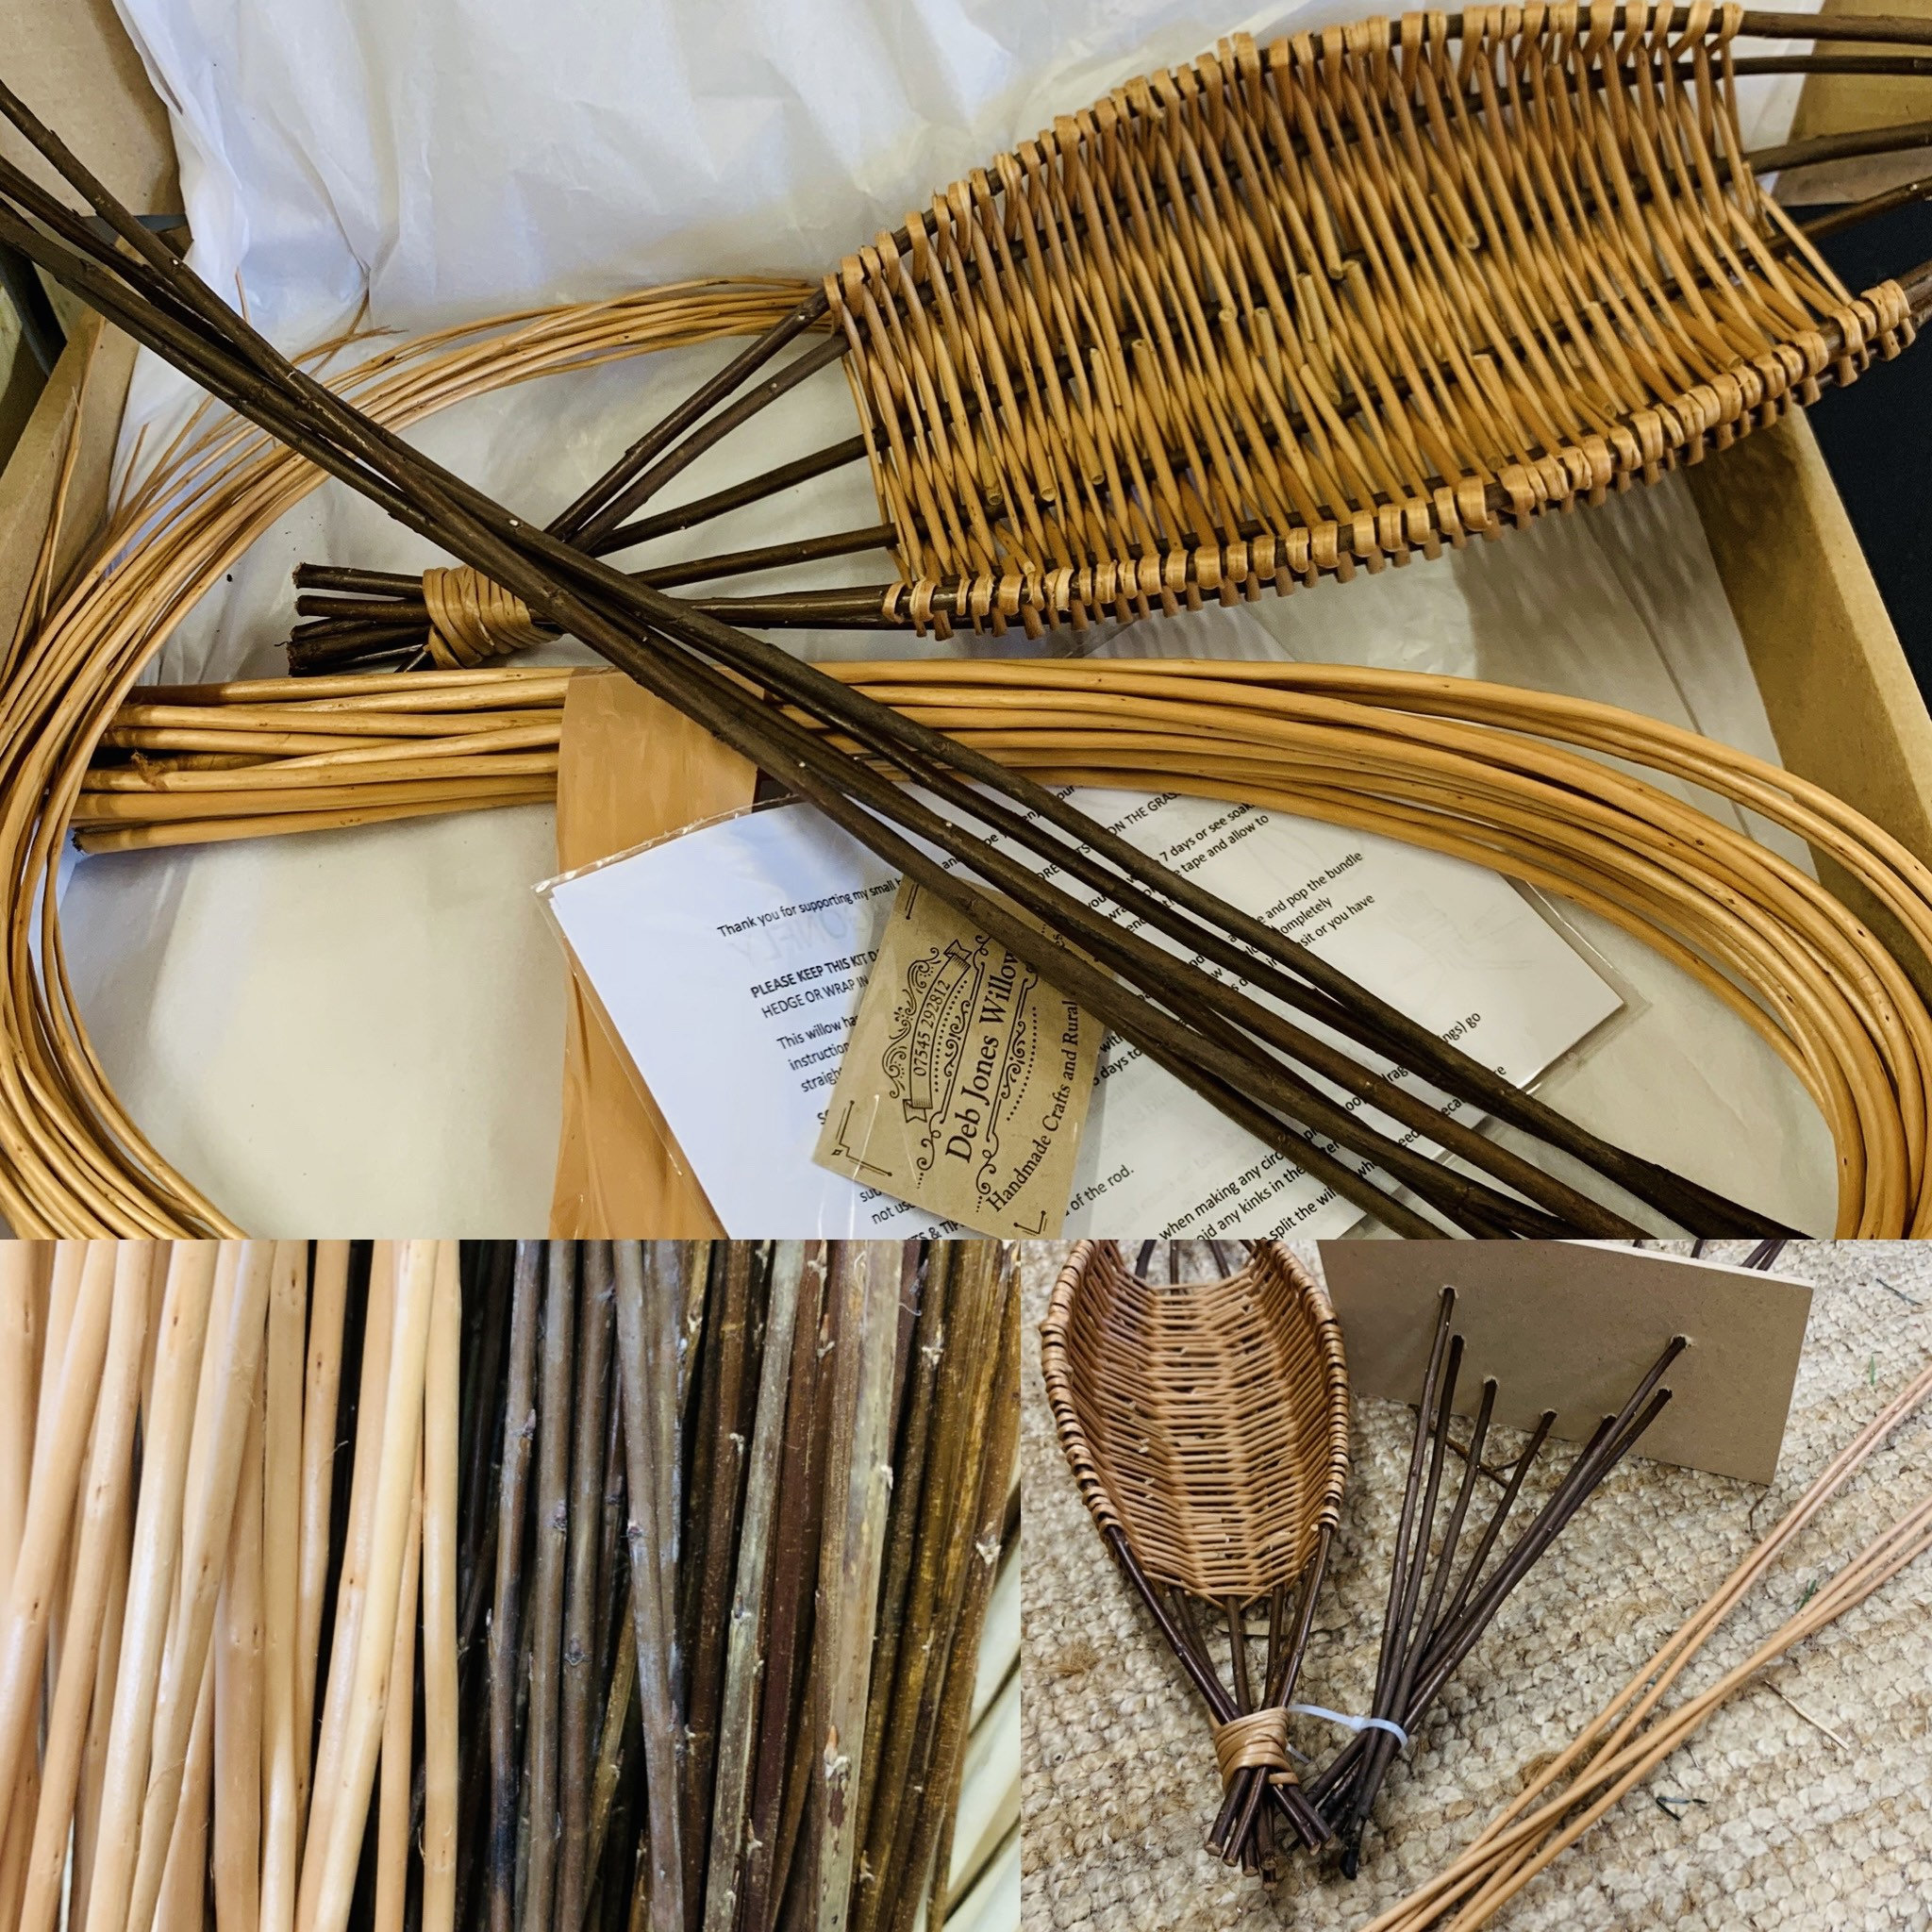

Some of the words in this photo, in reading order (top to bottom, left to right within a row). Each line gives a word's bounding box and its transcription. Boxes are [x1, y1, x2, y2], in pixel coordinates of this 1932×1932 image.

[1124, 807, 1148, 825] THE
[1159, 851, 1169, 862] 7
[1170, 838, 1196, 857] days
[1195, 828, 1208, 841] or
[1208, 818, 1228, 833] see
[1180, 854, 1208, 873] tape
[1207, 839, 1228, 857] and
[1227, 823, 1256, 844] allow
[1255, 815, 1270, 826] to
[1265, 901, 1287, 919] and
[1287, 888, 1308, 907] pop
[1307, 875, 1327, 891] the
[1324, 851, 1363, 879] bundle
[717, 917, 760, 937] Thank
[758, 911, 779, 926] you
[780, 905, 797, 917] for
[798, 893, 853, 913] supporting
[853, 890, 869, 901] my
[870, 880, 897, 896] small
[1280, 897, 1333, 934] ompletely
[1315, 924, 1328, 937] or
[1328, 912, 1349, 930] you
[1346, 894, 1375, 915] have
[750, 974, 797, 998] PLEASE
[796, 965, 824, 982] KEEP
[824, 958, 851, 974] THIS
[850, 953, 868, 967] KIT
[761, 994, 805, 1019] HEDGE
[806, 988, 824, 1003] OR
[822, 978, 855, 997] WRAP
[921, 979, 951, 1031] 292812
[1061, 1000, 1079, 1047] Rural
[1465, 1012, 1482, 1028] go
[776, 1032, 805, 1049] This
[806, 1022, 841, 1040] willow
[913, 1031, 931, 1077] 07545
[960, 1035, 999, 1107] Jones
[1062, 1049, 1078, 1082] and
[1100, 1057, 1129, 1079] days
[1128, 1047, 1142, 1060] to
[1041, 1084, 1071, 1132] Crafts
[944, 1108, 981, 1163] Deb
[987, 1136, 1052, 1213] Handmade
[1070, 1192, 1085, 1210] of
[1084, 1183, 1108, 1201] the
[1108, 1164, 1135, 1187] rod.
[872, 1207, 894, 1224] not
[1158, 1213, 1195, 1240] when
[1194, 1182, 1241, 1217] making
[1238, 1165, 1262, 1187] any
[1217, 1210, 1242, 1231] any
[1241, 1188, 1273, 1214] kinks
[1271, 1180, 1285, 1194] in
[1285, 1165, 1307, 1183] the
[1267, 1216, 1297, 1240] split
[1294, 1201, 1318, 1223] the
